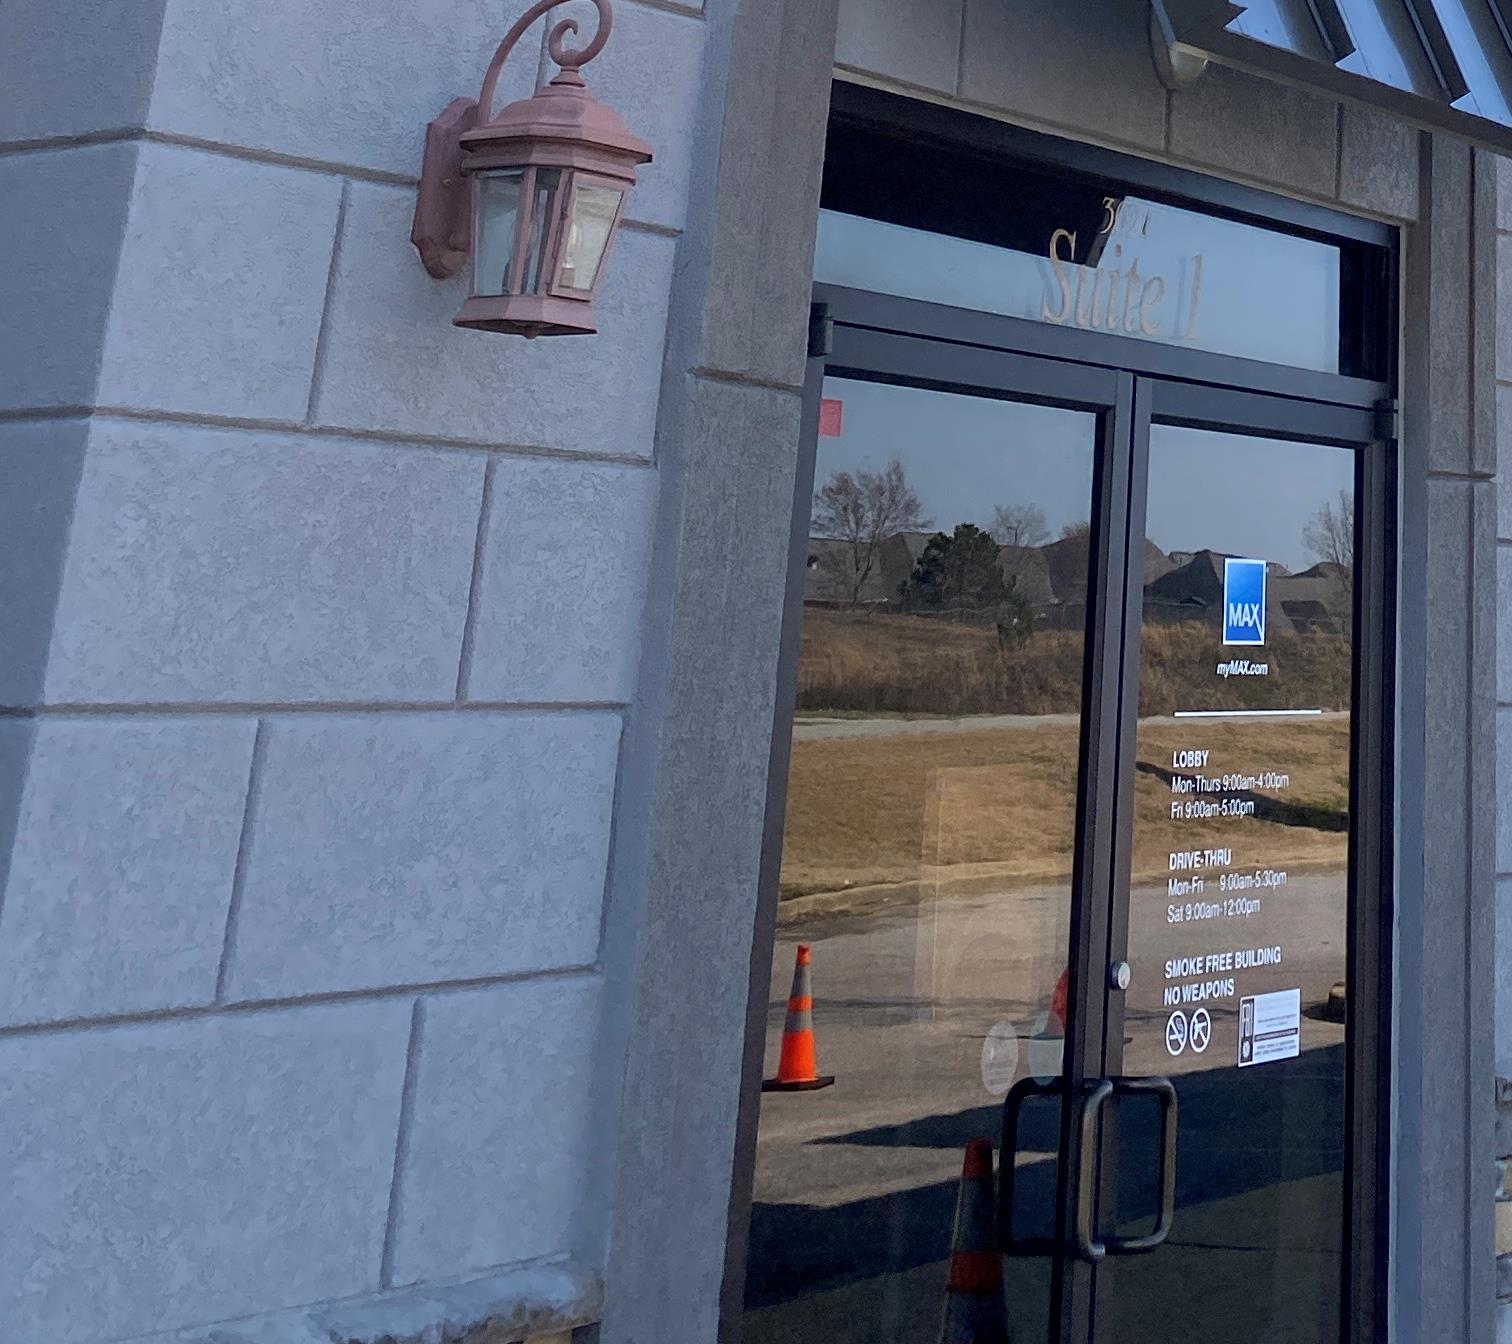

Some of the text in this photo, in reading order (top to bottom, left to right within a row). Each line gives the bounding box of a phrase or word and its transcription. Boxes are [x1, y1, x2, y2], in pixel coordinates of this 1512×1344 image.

[1041, 228, 1166, 337] Suite
[1229, 602, 1260, 627] MAX
[1216, 659, 1268, 678] myMAX.com
[1172, 750, 1209, 768] LOBBY
[1171, 772, 1289, 794] Mon-Thurs 9:00am-4:00pm
[1170, 799, 1254, 819] Fri 9:00am-5:00pm
[1169, 848, 1232, 870] DRIVE-THRU
[1168, 870, 1287, 897] Mon-Fri 9:00am-5:30pm
[1167, 897, 1261, 923] Sat 9:00am-12:00pm
[1165, 946, 1281, 979] SMOKE FREE BUILDING
[1164, 978, 1235, 1006] NO WEAPONS
